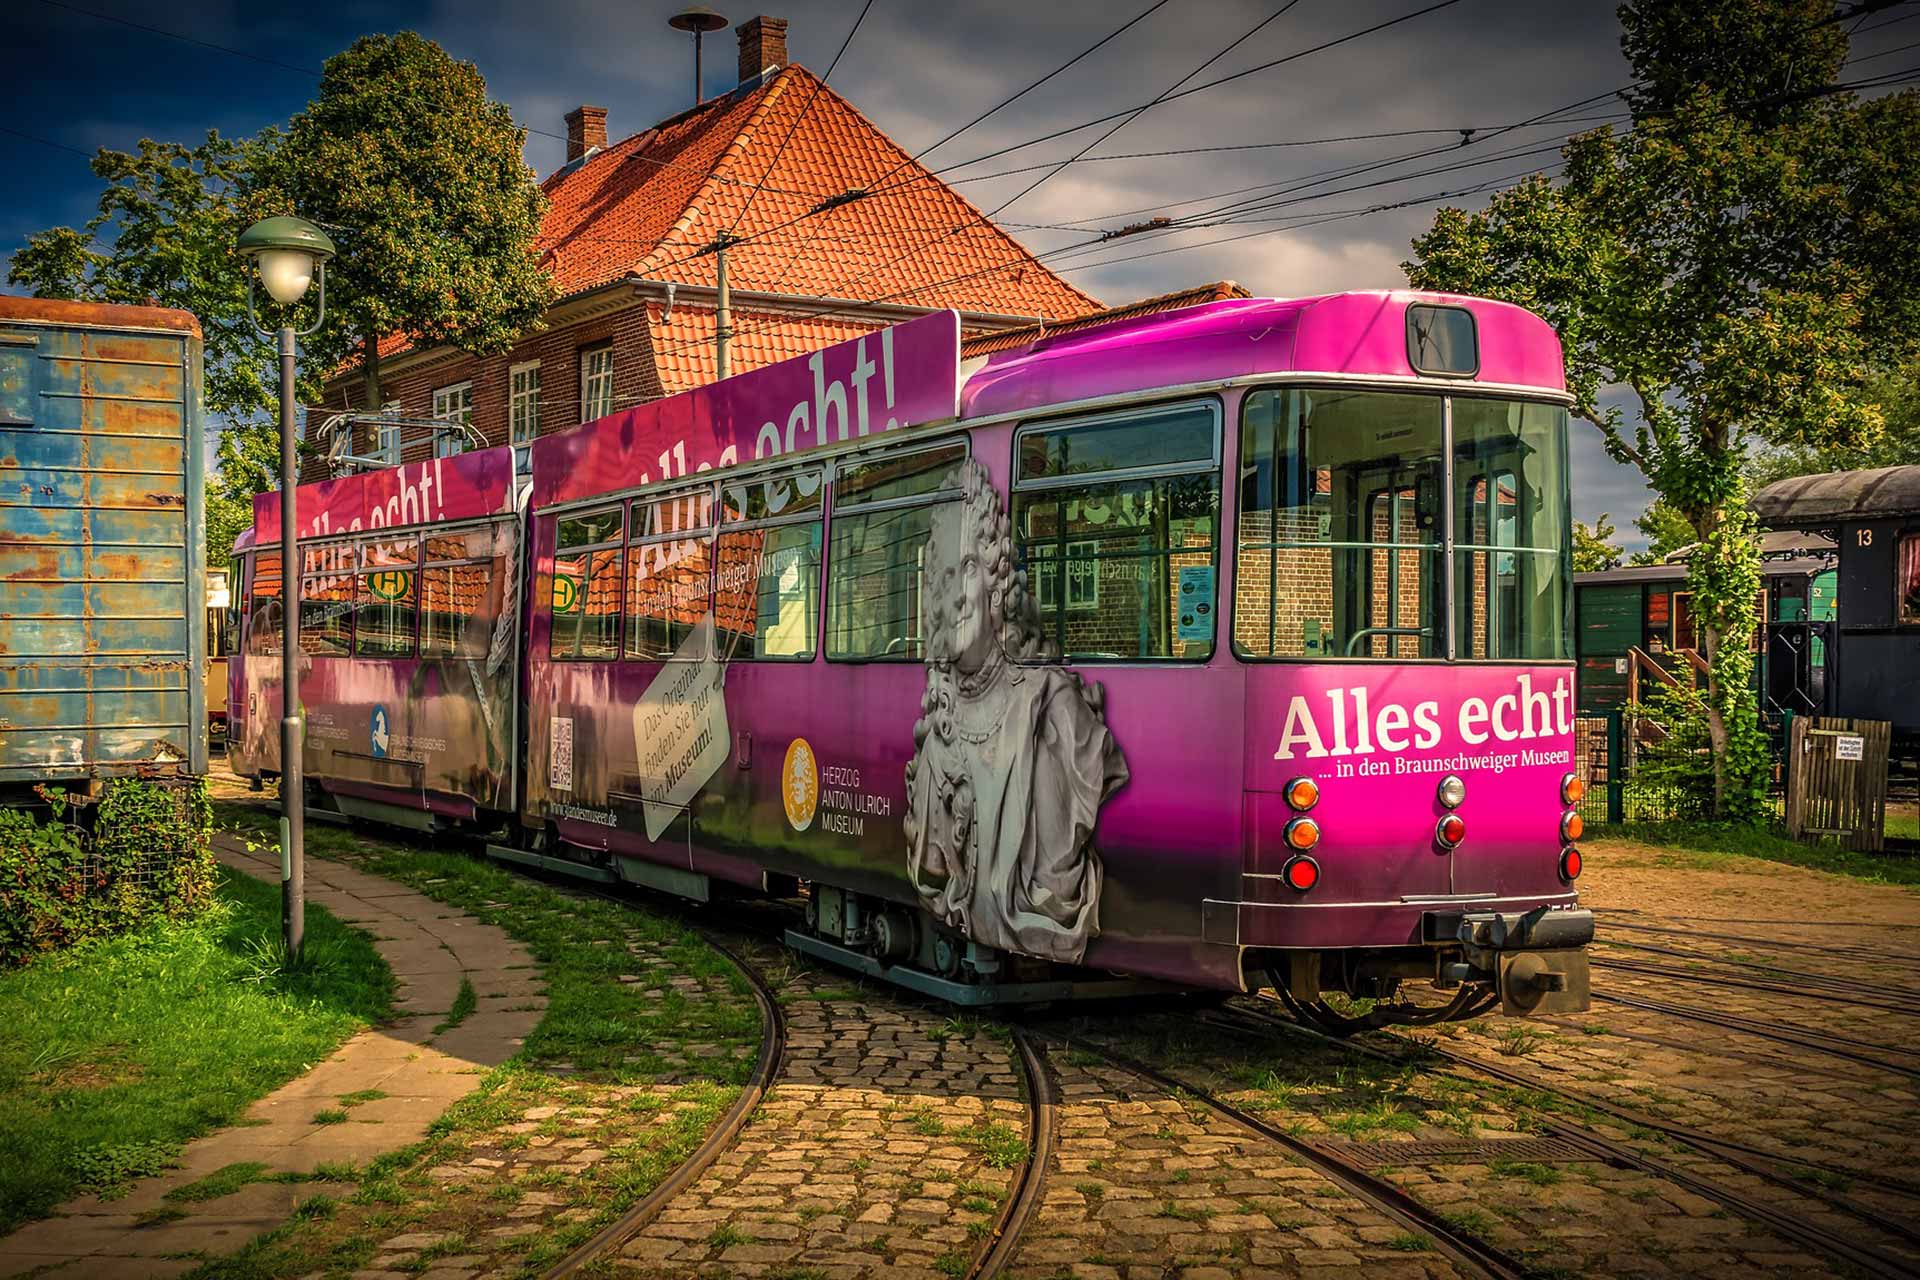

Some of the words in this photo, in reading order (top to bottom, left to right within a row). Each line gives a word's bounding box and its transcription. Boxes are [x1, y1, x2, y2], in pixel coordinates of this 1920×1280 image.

[1857, 529, 1873, 546] 13
[643, 706, 662, 741] Das
[662, 650, 702, 716] Original
[676, 710, 690, 741] Sie
[691, 684, 710, 721] nur
[1274, 686, 1441, 760] Alles
[1458, 671, 1575, 744] echt!
[650, 784, 665, 811] im
[664, 718, 714, 795] Museum!
[822, 766, 860, 788] HERZOG
[1336, 760, 1354, 778] in
[1359, 758, 1391, 777] den
[1395, 751, 1517, 774] Braunschweiger
[1521, 749, 1570, 767] Museen
[821, 789, 853, 811] ANTON
[855, 794, 890, 816] ULRICH
[822, 812, 864, 836] MUSEUM
